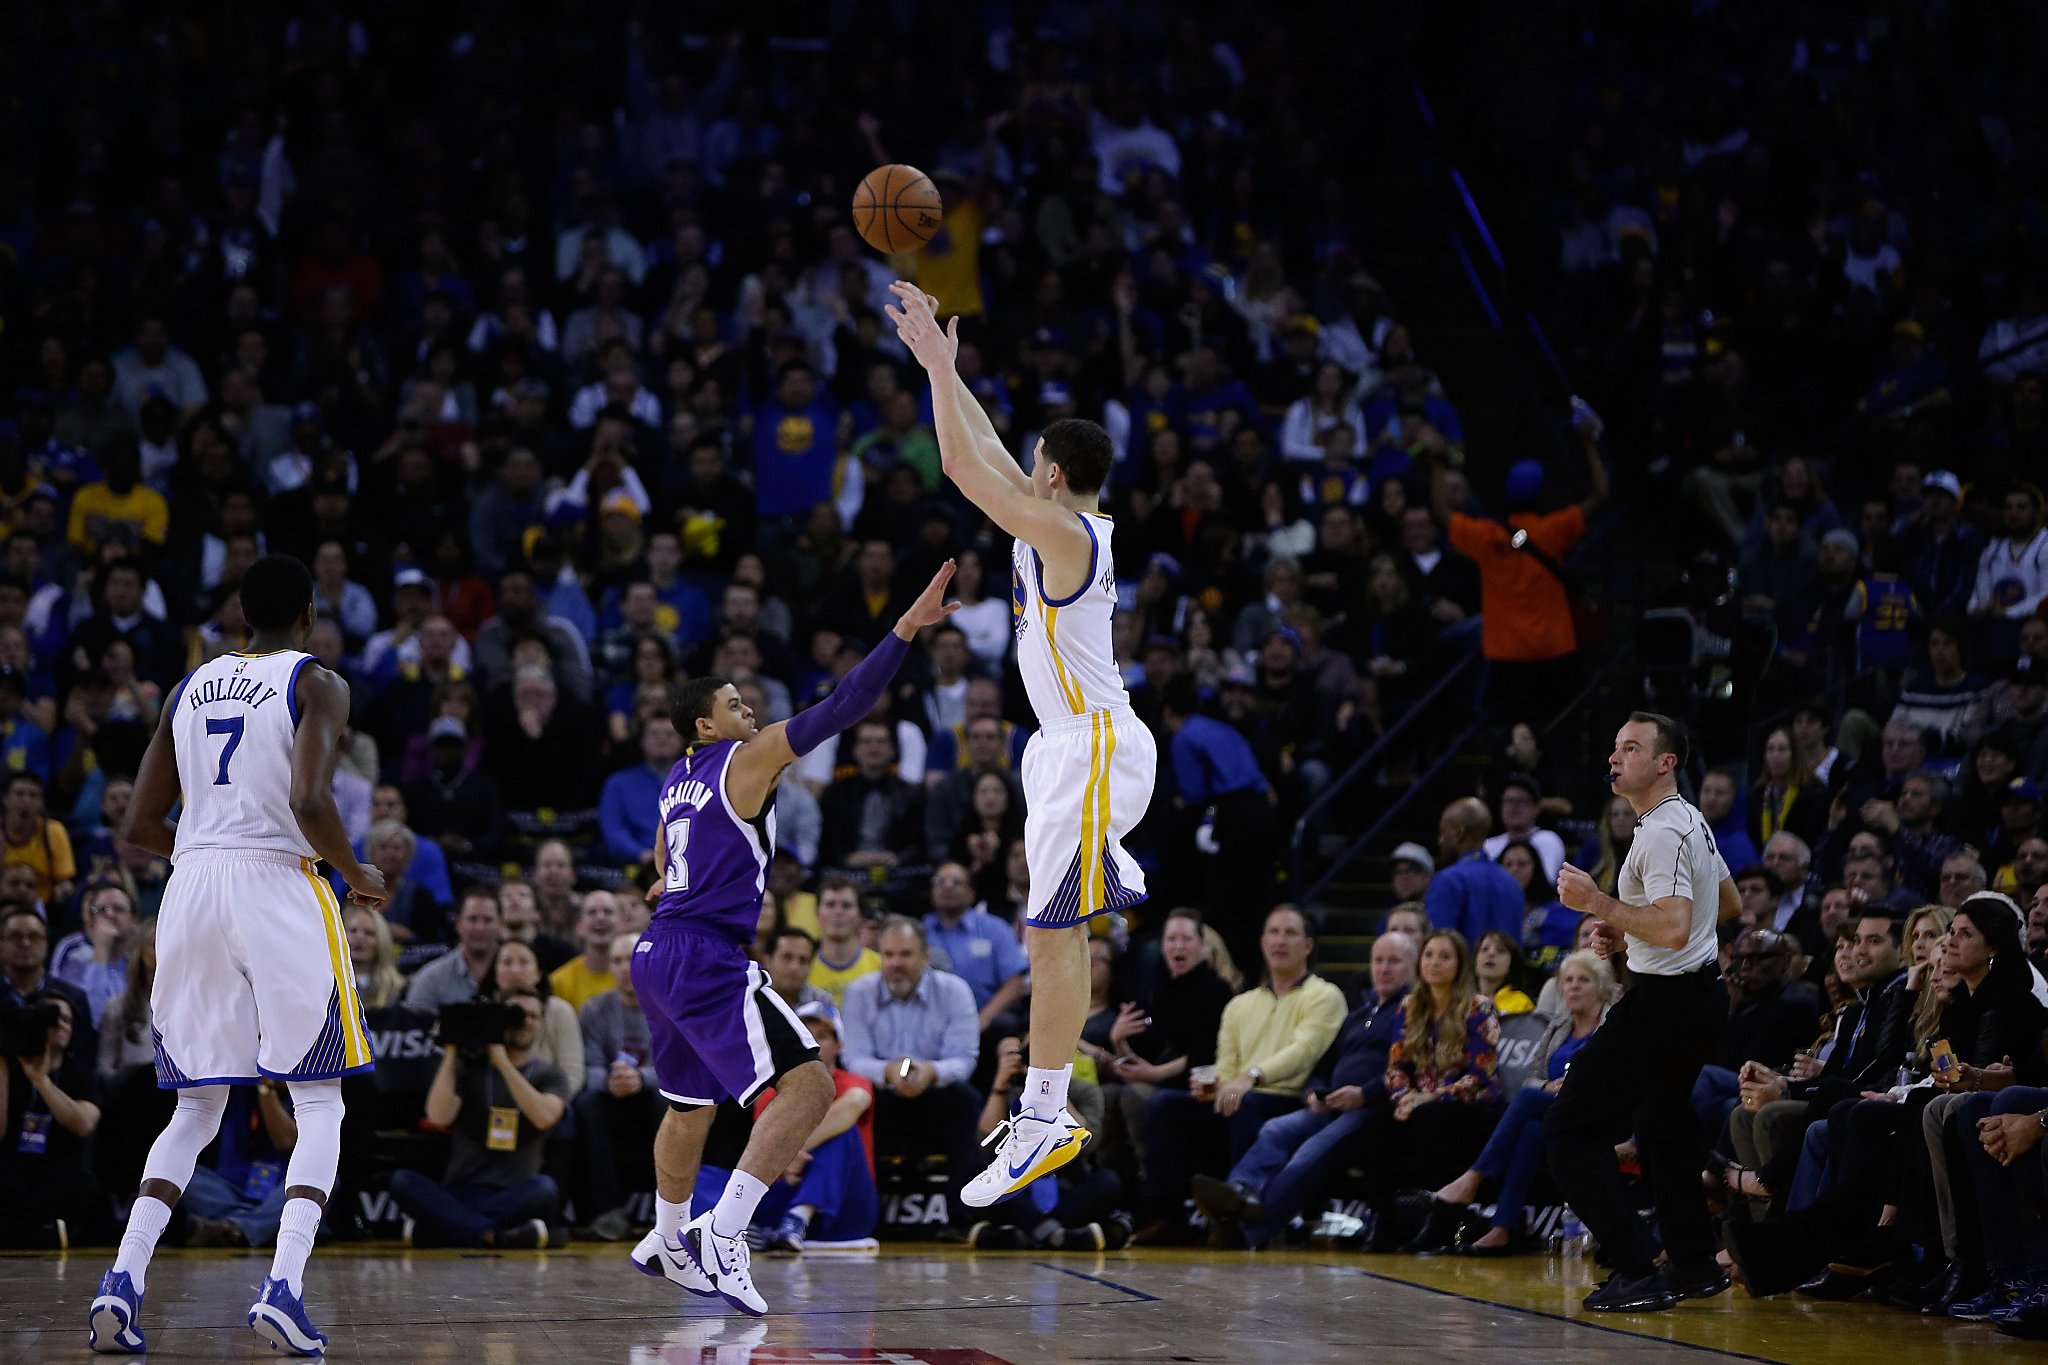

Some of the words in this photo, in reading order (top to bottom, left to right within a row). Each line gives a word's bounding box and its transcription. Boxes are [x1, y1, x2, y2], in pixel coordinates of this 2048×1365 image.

[189, 676, 278, 711] HOLIDAY
[205, 712, 245, 785] 7
[665, 818, 691, 893] 3
[882, 1192, 950, 1225] ISA
